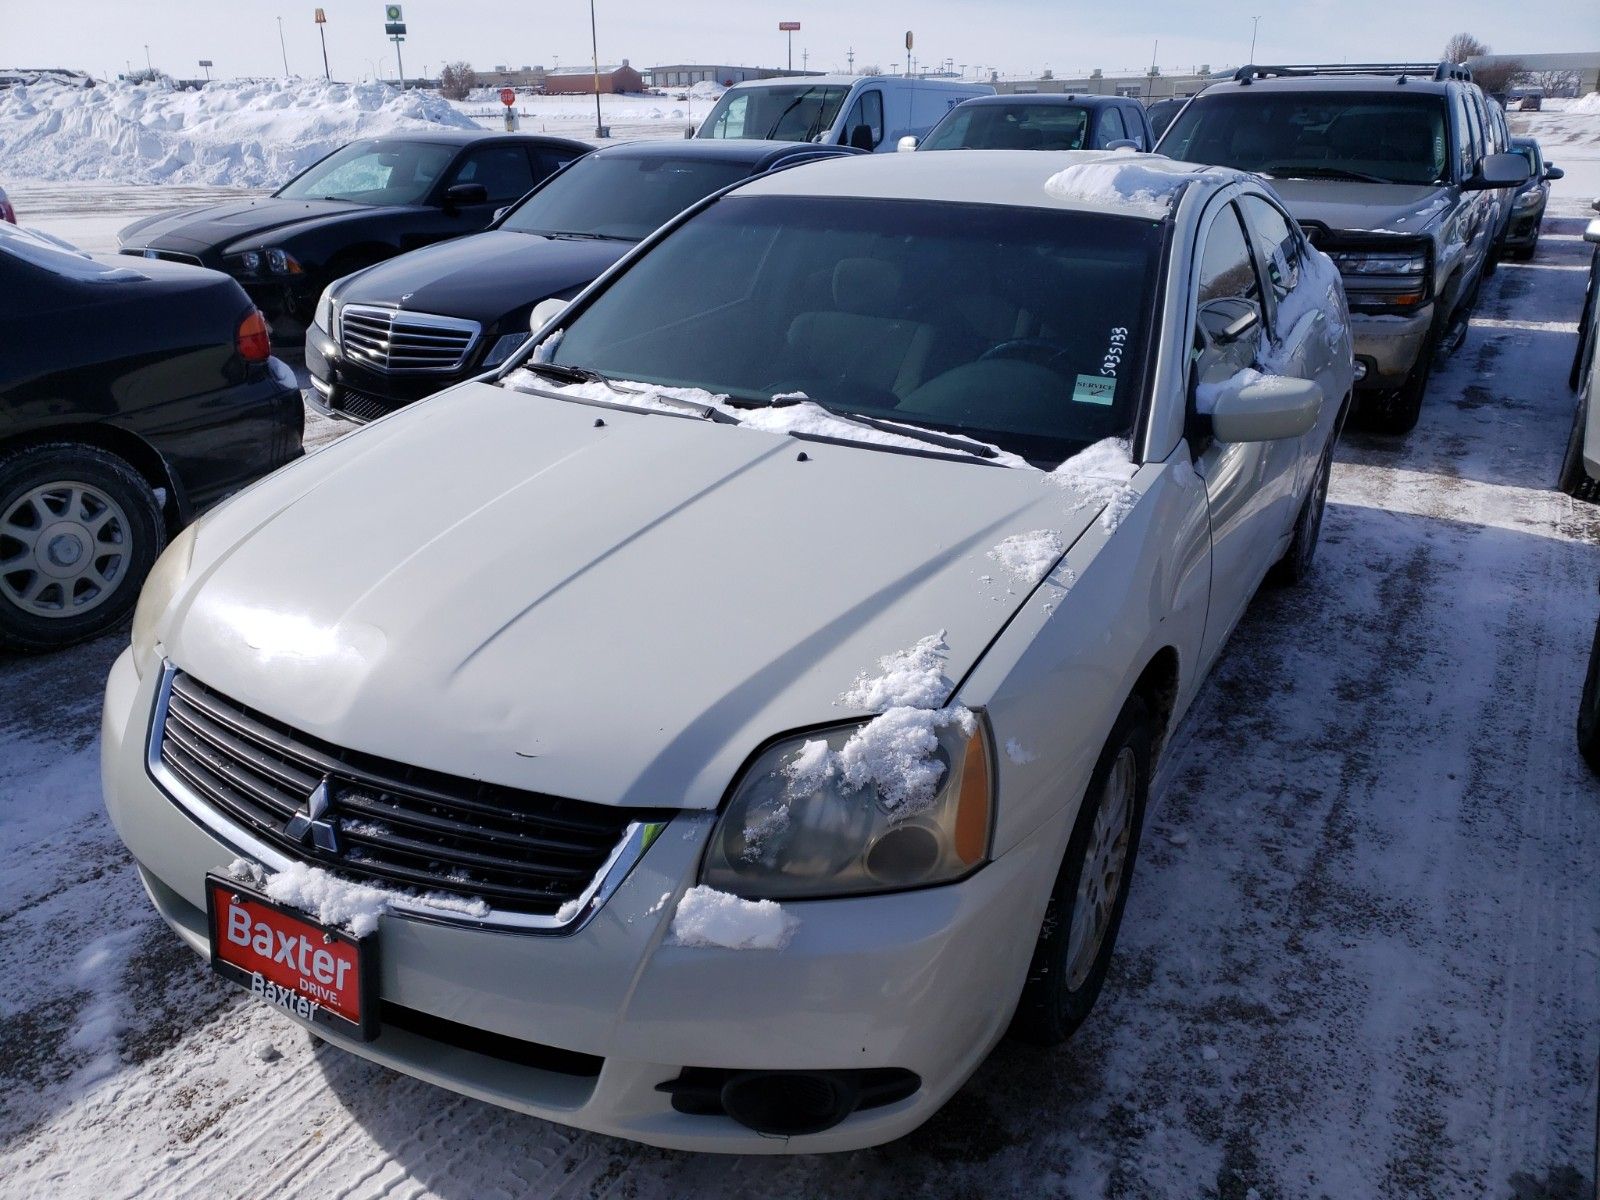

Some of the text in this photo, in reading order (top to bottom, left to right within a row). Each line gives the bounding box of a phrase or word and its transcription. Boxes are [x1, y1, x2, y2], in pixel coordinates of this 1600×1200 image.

[1077, 382, 1114, 391] SERVICE
[227, 904, 351, 991] Baxter
[251, 971, 320, 1022] Baxter
